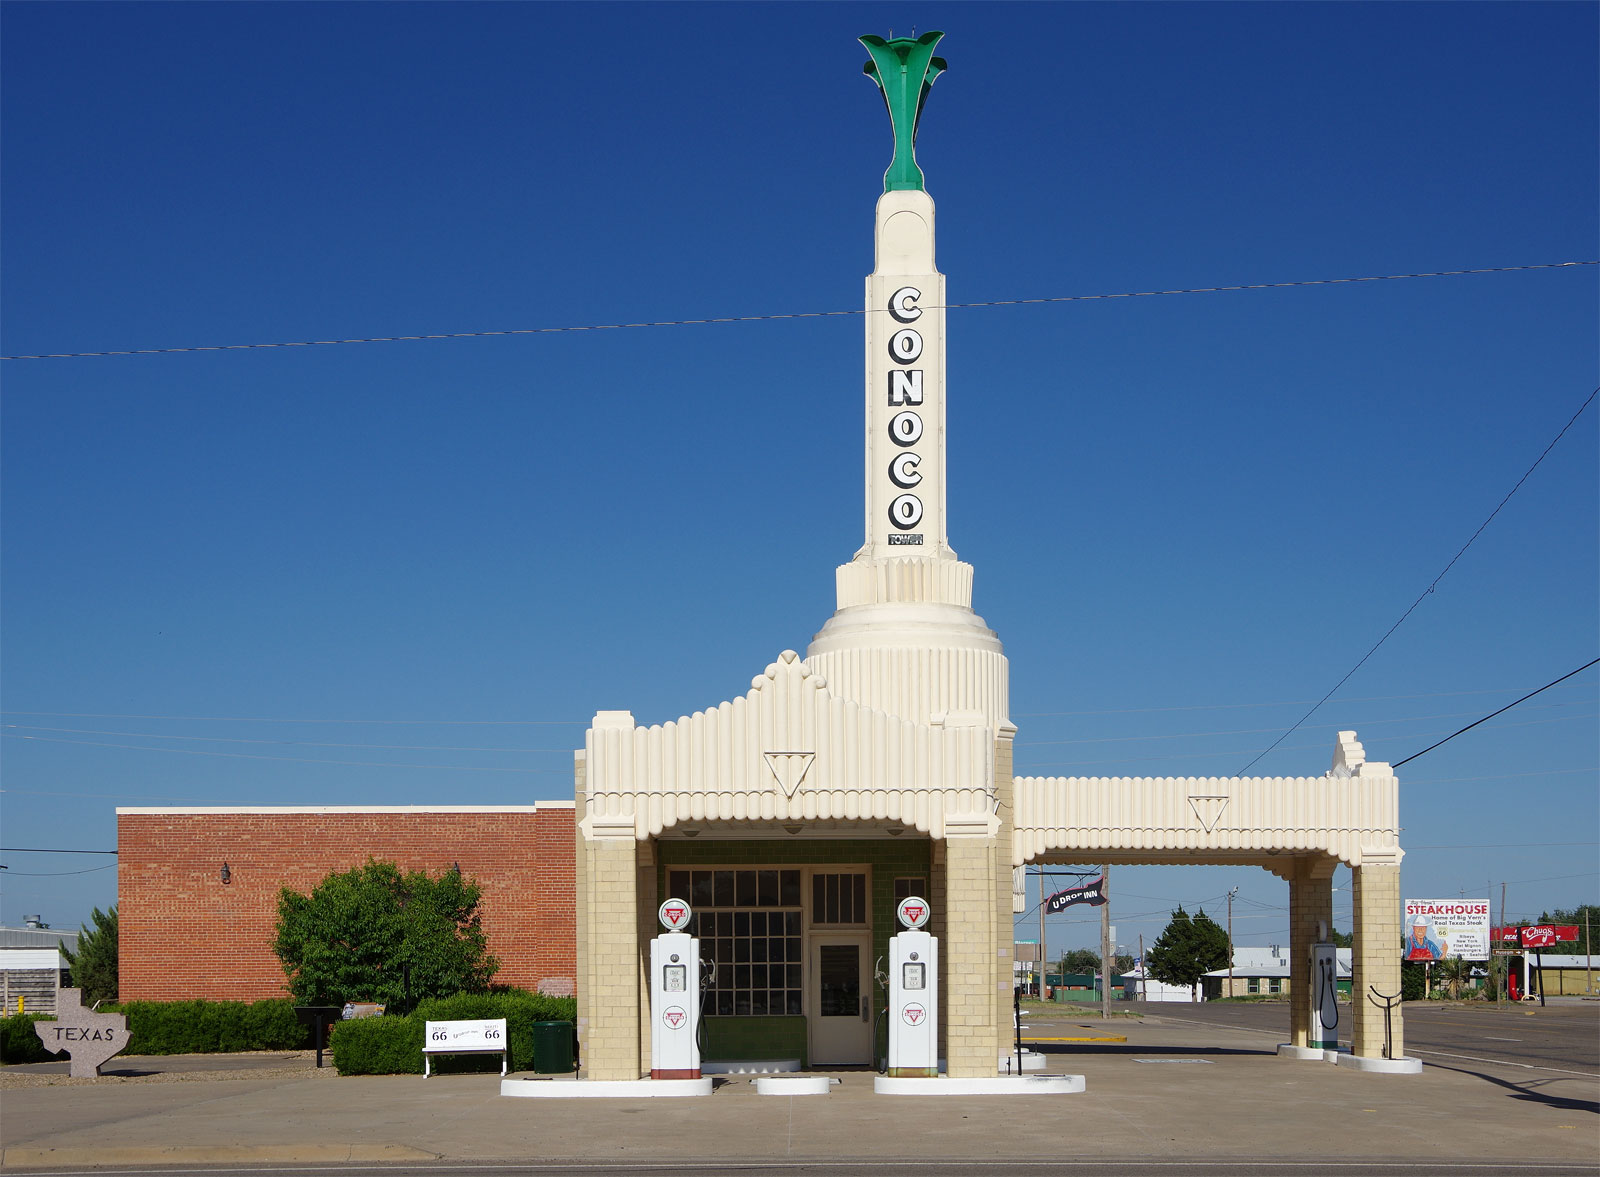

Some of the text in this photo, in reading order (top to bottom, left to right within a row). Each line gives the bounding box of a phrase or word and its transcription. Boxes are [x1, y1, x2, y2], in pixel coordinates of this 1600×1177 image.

[888, 286, 923, 530] CONOCO
[890, 535, 922, 544] TOWER
[1083, 890, 1098, 899] INN
[1407, 905, 1487, 914] STEAKHOUSE
[53, 1027, 114, 1041] TEXAS
[432, 1031, 448, 1041] 66
[484, 1029, 500, 1039] 66
